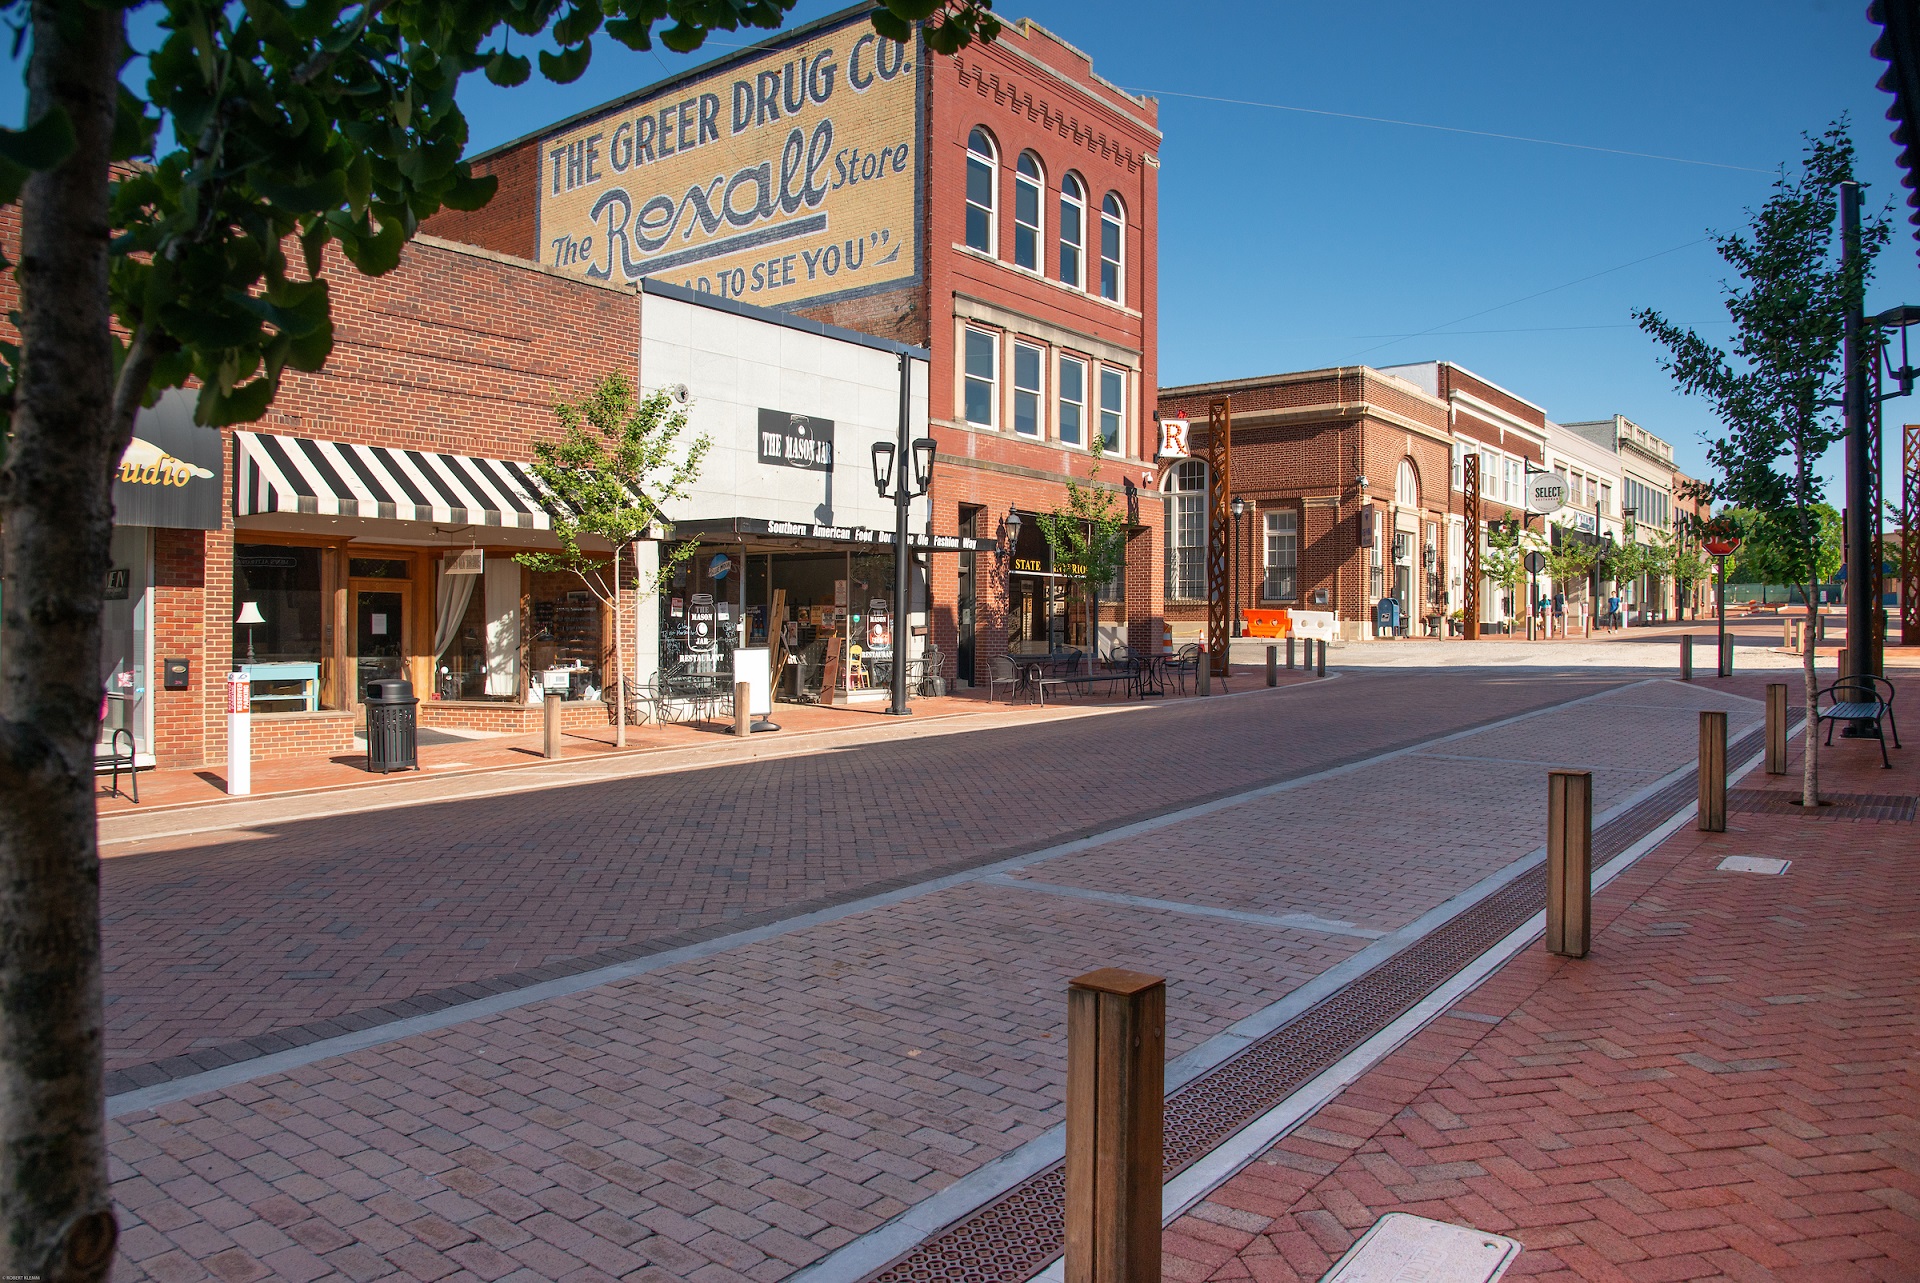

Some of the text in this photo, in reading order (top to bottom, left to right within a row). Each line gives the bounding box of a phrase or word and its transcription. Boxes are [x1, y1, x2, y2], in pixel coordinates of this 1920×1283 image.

[549, 33, 912, 198] THE GREER DRUG CO.
[551, 118, 910, 282] The Rexall Store
[717, 267, 747, 298] TO
[750, 251, 797, 293] SEE
[762, 431, 832, 465] THE MASON JAR
[114, 454, 191, 488] udio
[1535, 486, 1561, 498] SELECT
[768, 520, 807, 536] Southern
[812, 525, 851, 541] American
[854, 528, 874, 543] Food
[933, 535, 960, 549] Fashion
[962, 536, 977, 550] Way
[1015, 558, 1042, 571] STATE
[695, 606, 710, 614] THE
[691, 613, 713, 621] MASON
[695, 637, 709, 645] JAR
[679, 653, 724, 662] RESTAURANT
[861, 651, 894, 659] RESTAURAN
